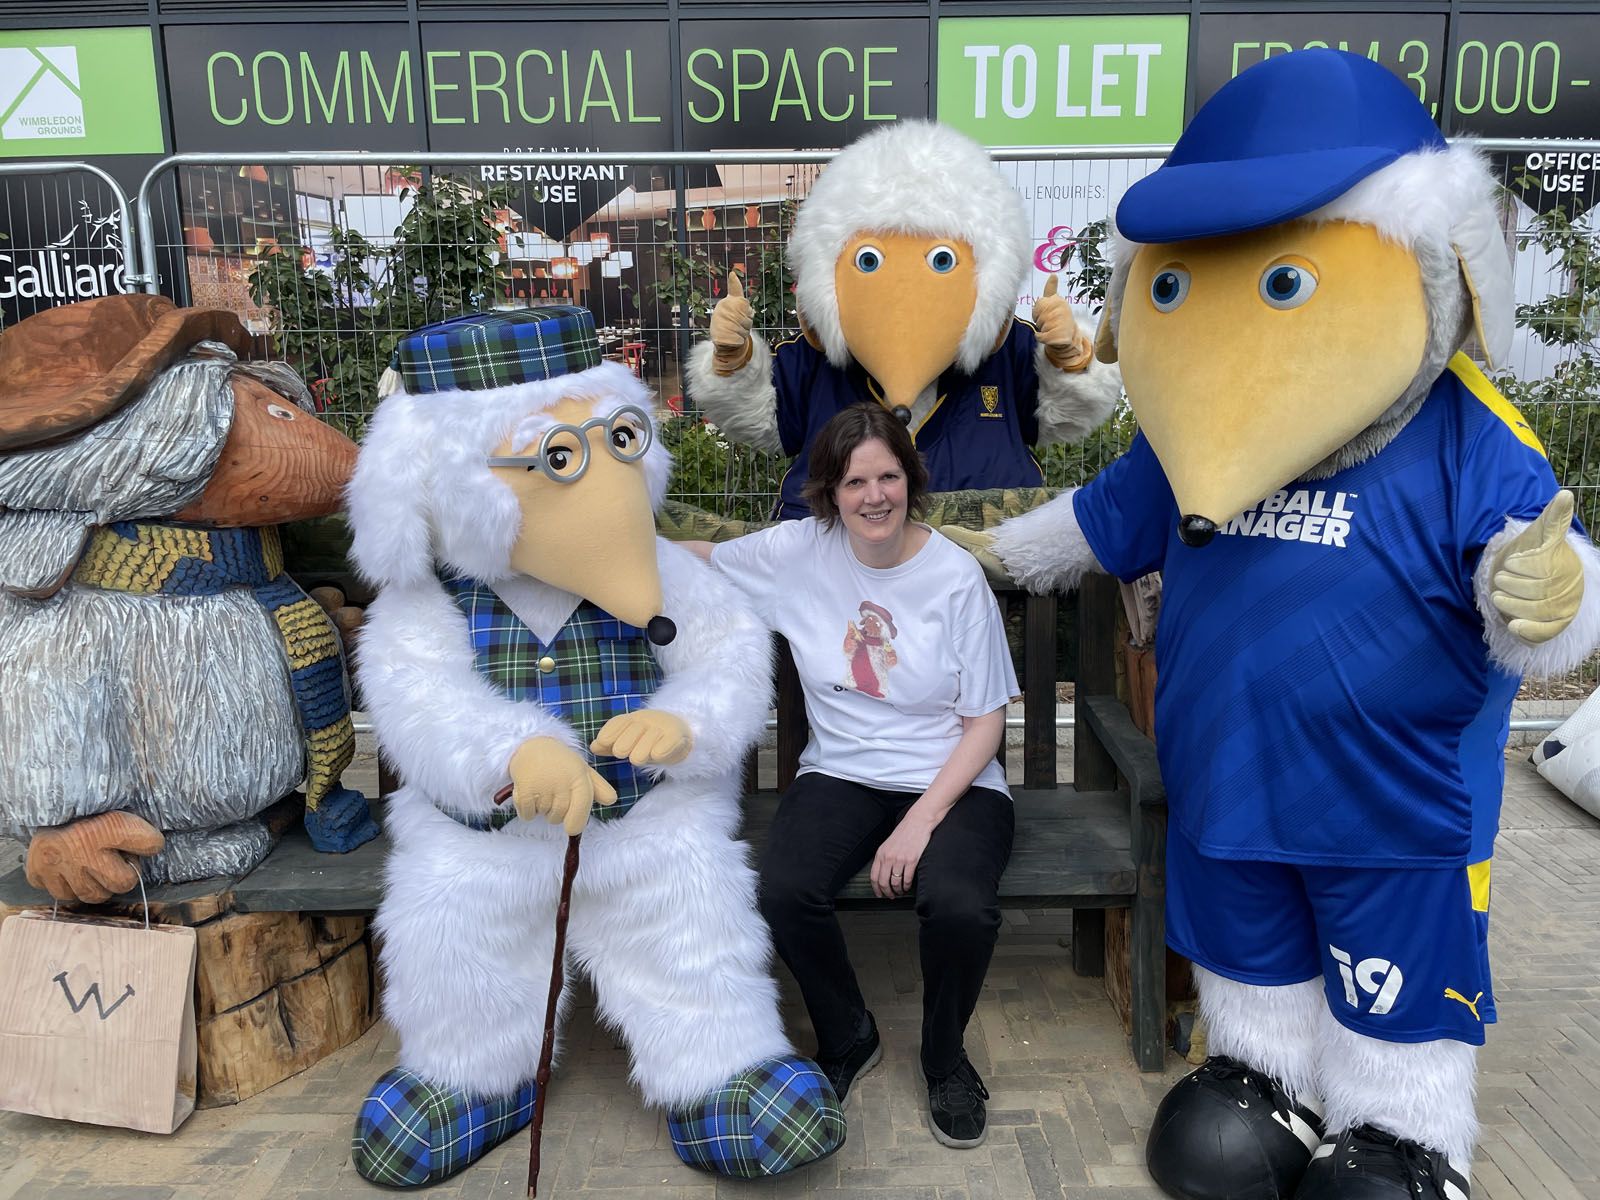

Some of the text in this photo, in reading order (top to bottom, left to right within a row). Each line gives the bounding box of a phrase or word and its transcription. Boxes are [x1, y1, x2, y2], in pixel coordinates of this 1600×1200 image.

[206, 49, 662, 126] COMMERCIAL
[686, 46, 899, 124] SPACE
[963, 44, 1037, 119] TO
[1055, 43, 1162, 118] LET
[18, 116, 82, 126] WIMBLEDON
[37, 126, 83, 135] GROUNDS
[1526, 152, 1600, 171] OFFICE
[480, 164, 629, 182] RESTAURANT
[1543, 174, 1586, 192] USE
[534, 185, 578, 203] USE
[1036, 185, 1106, 200] ENQUIRIES:
[1249, 489, 1354, 520] BALL
[52, 971, 136, 1020] W
